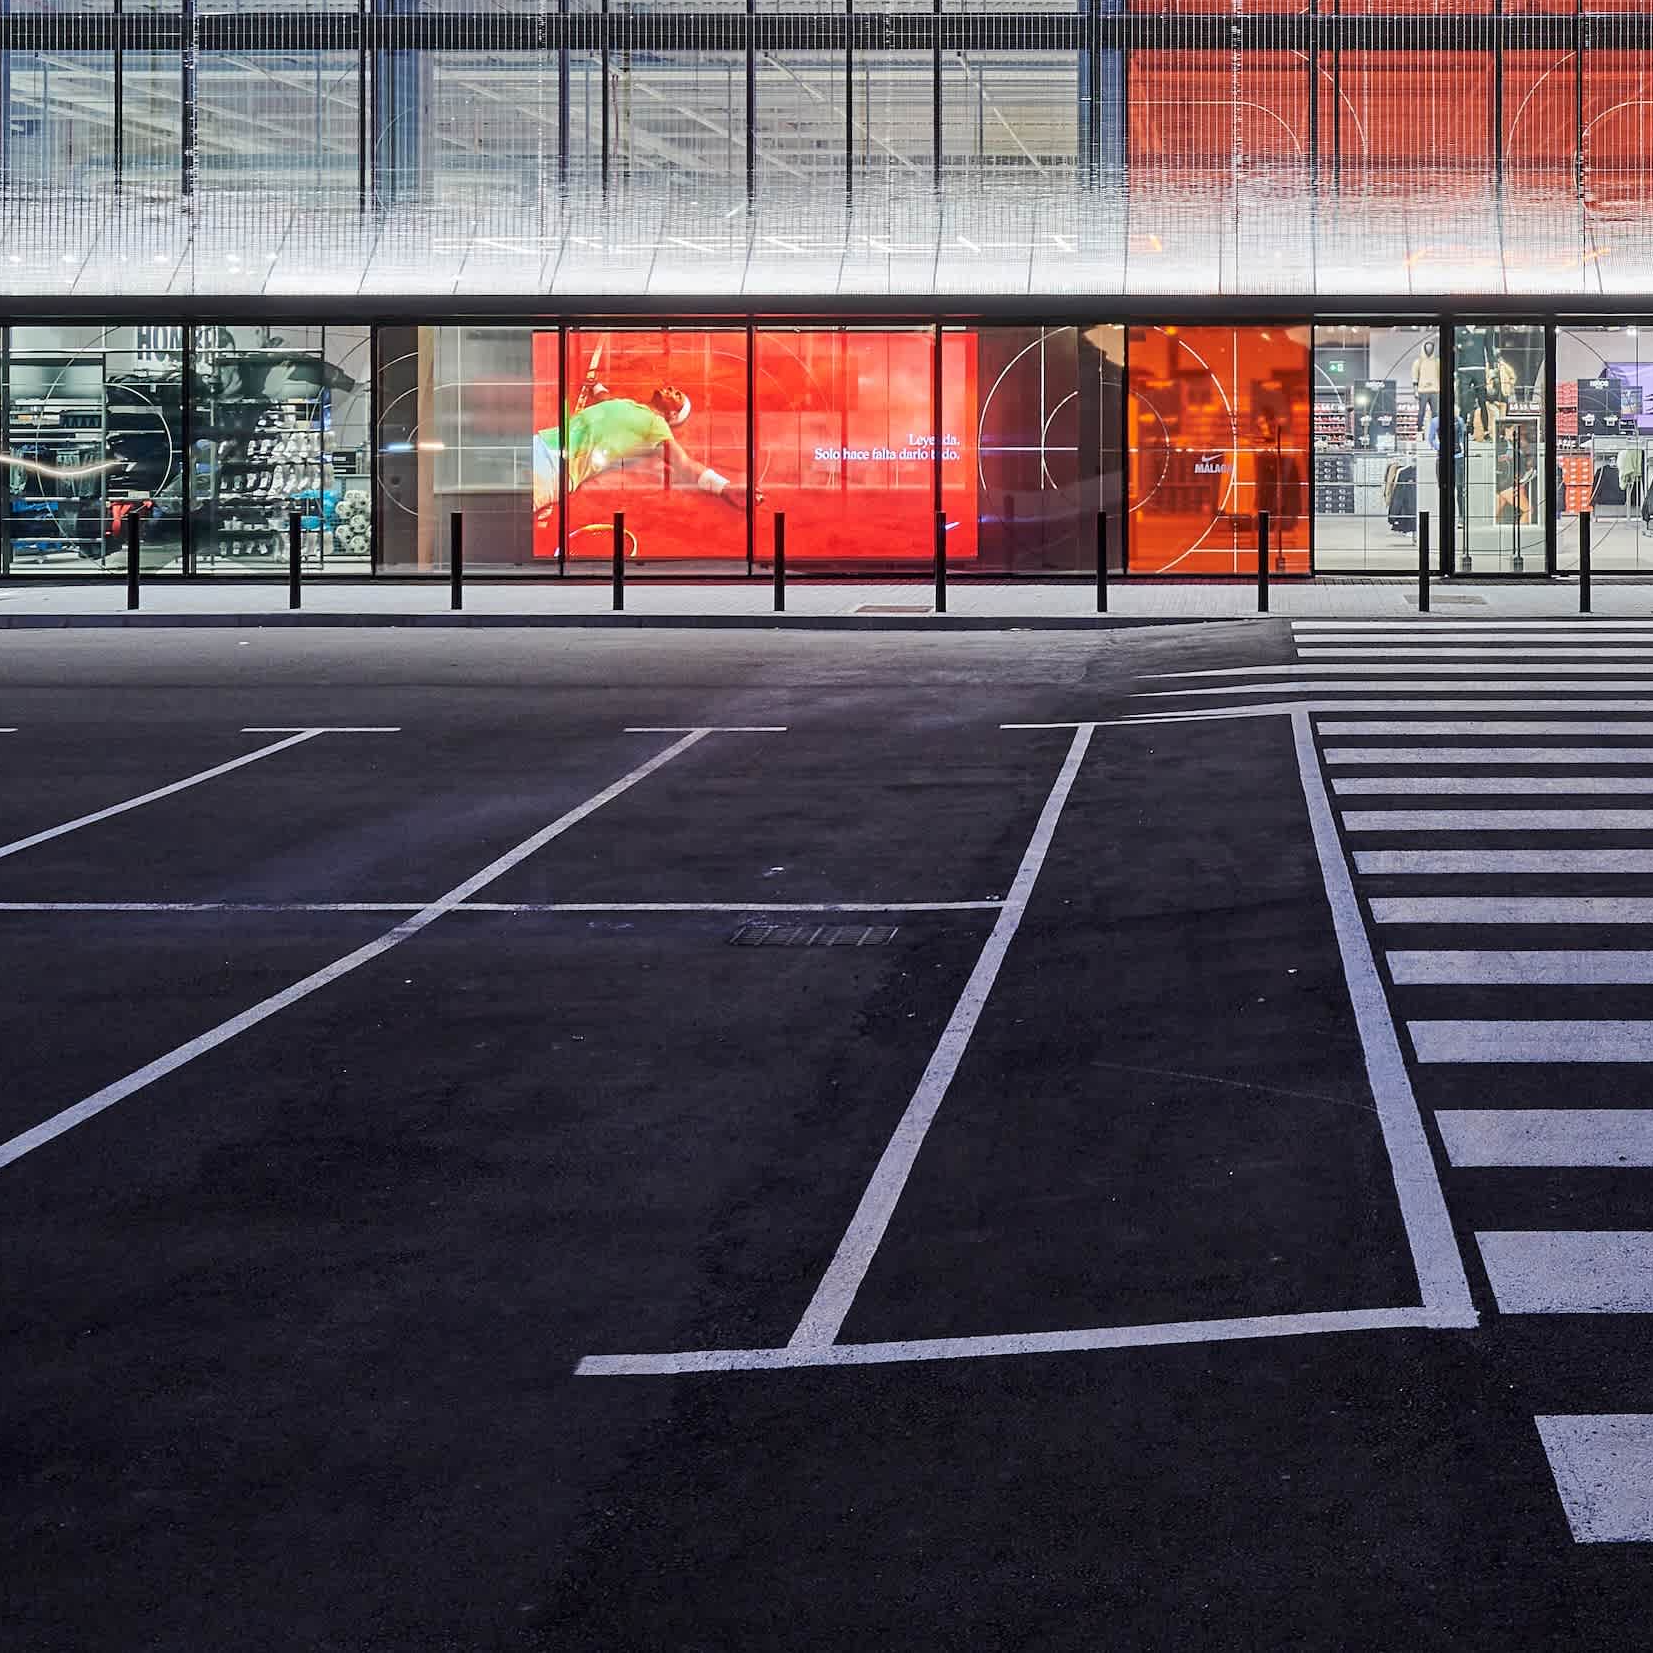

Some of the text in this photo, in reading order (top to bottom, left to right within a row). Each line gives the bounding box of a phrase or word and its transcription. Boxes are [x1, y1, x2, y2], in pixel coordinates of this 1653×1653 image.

[909, 434, 961, 449] Leyeda.
[814, 447, 961, 460] Solo hace falta darlo tdo.
